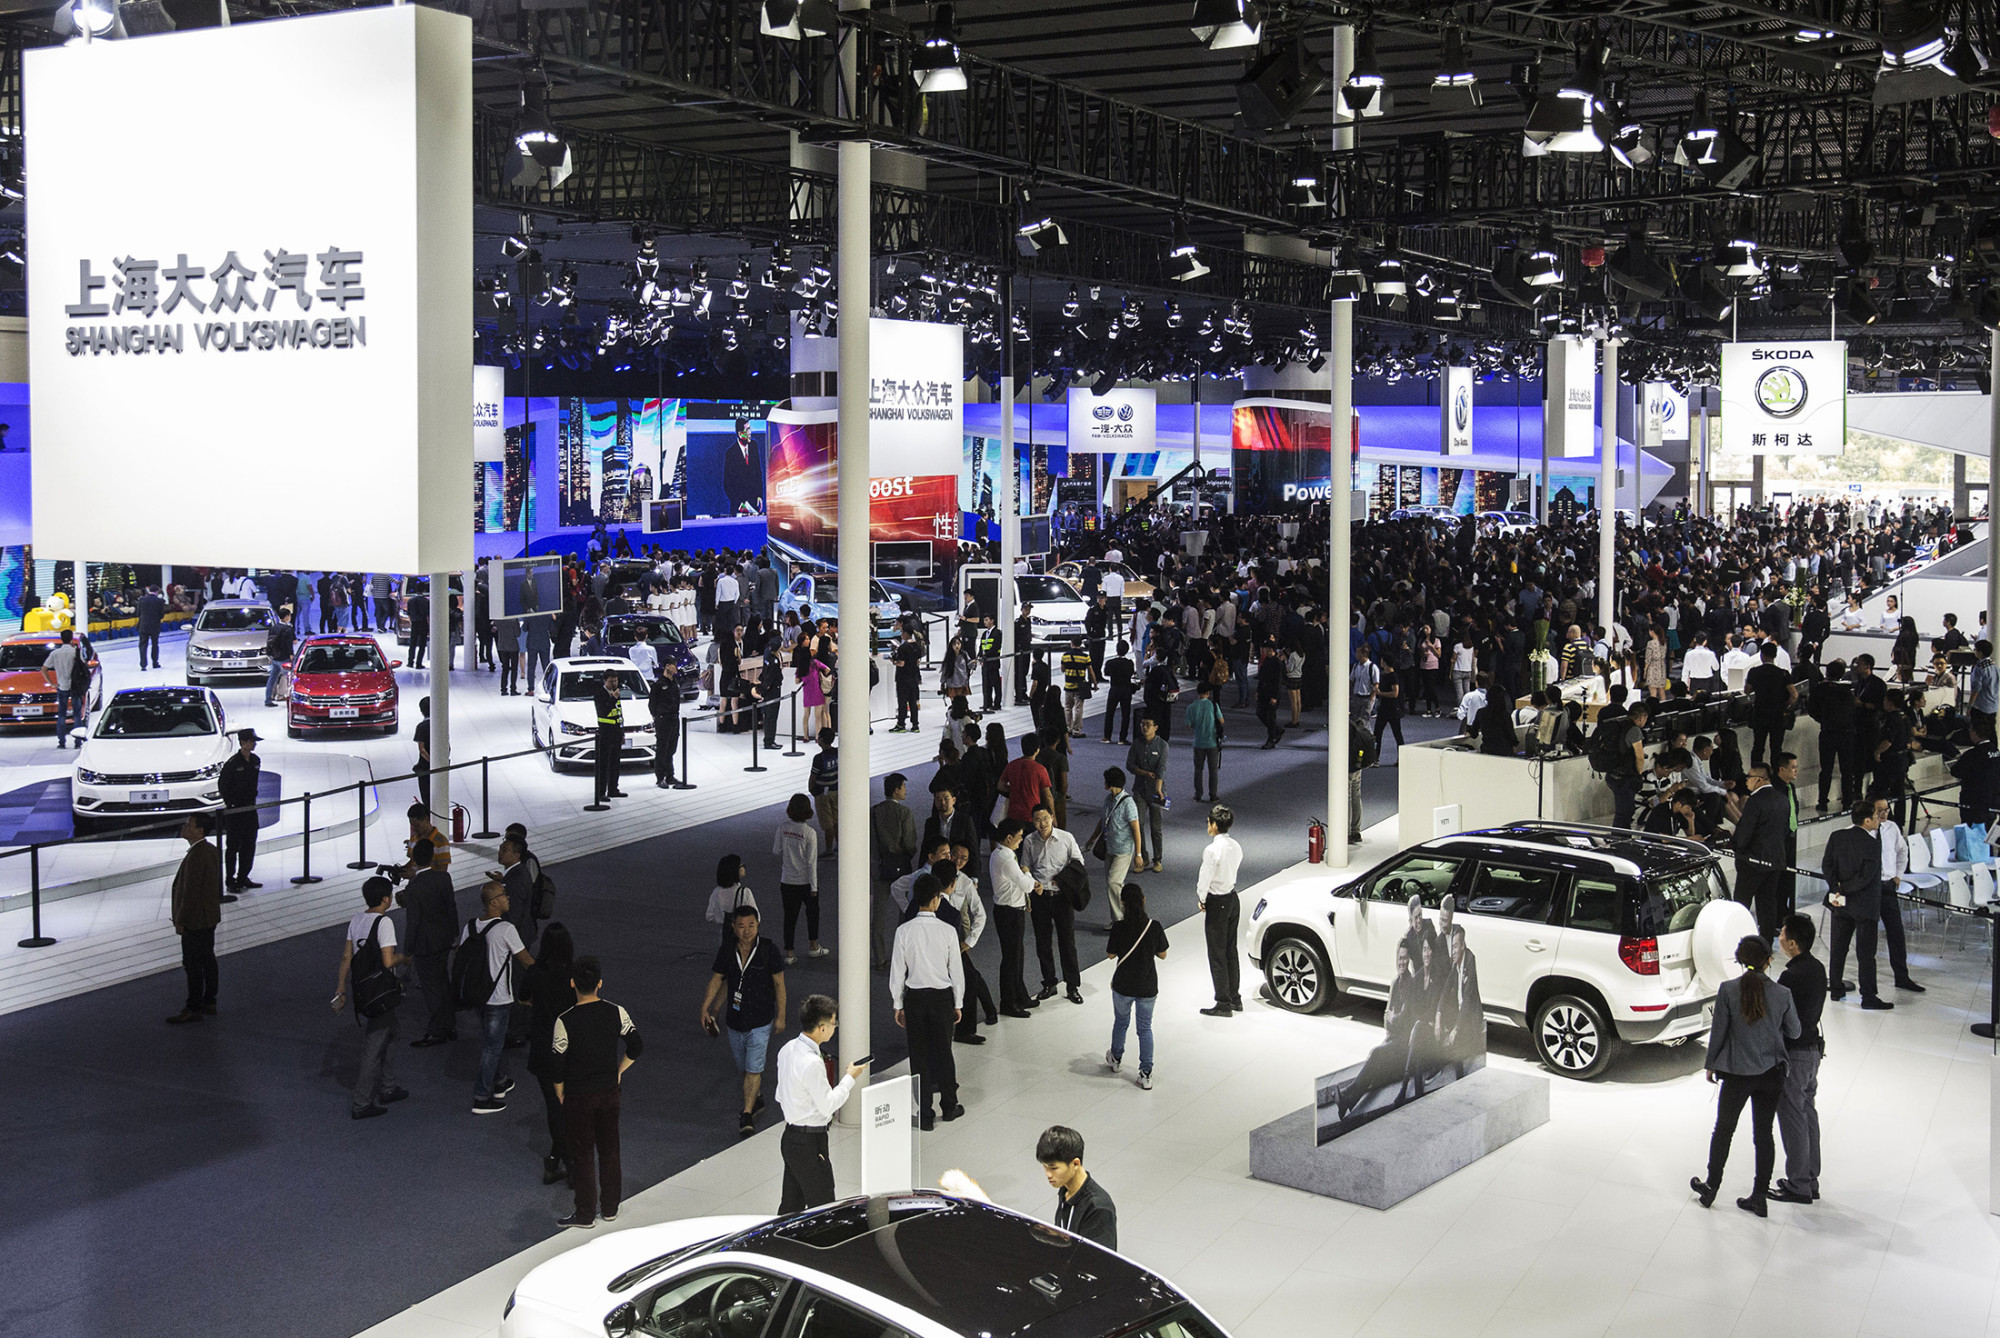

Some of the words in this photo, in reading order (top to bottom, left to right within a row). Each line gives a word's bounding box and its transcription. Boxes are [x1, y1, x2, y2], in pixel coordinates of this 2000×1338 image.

[65, 246, 365, 318] 上海大众汽车
[65, 324, 183, 355] SHANGHAI
[194, 316, 366, 352] VOLKSWAGEN
[1752, 349, 1813, 360] ŠKODA
[869, 378, 953, 406] 上海大众汽车
[473, 402, 498, 418] 众汽车
[907, 408, 953, 421] VOLKSWAGEN
[1752, 433, 1813, 446] 斯柯达
[869, 476, 914, 498] oost
[1283, 483, 1332, 502] Powe
